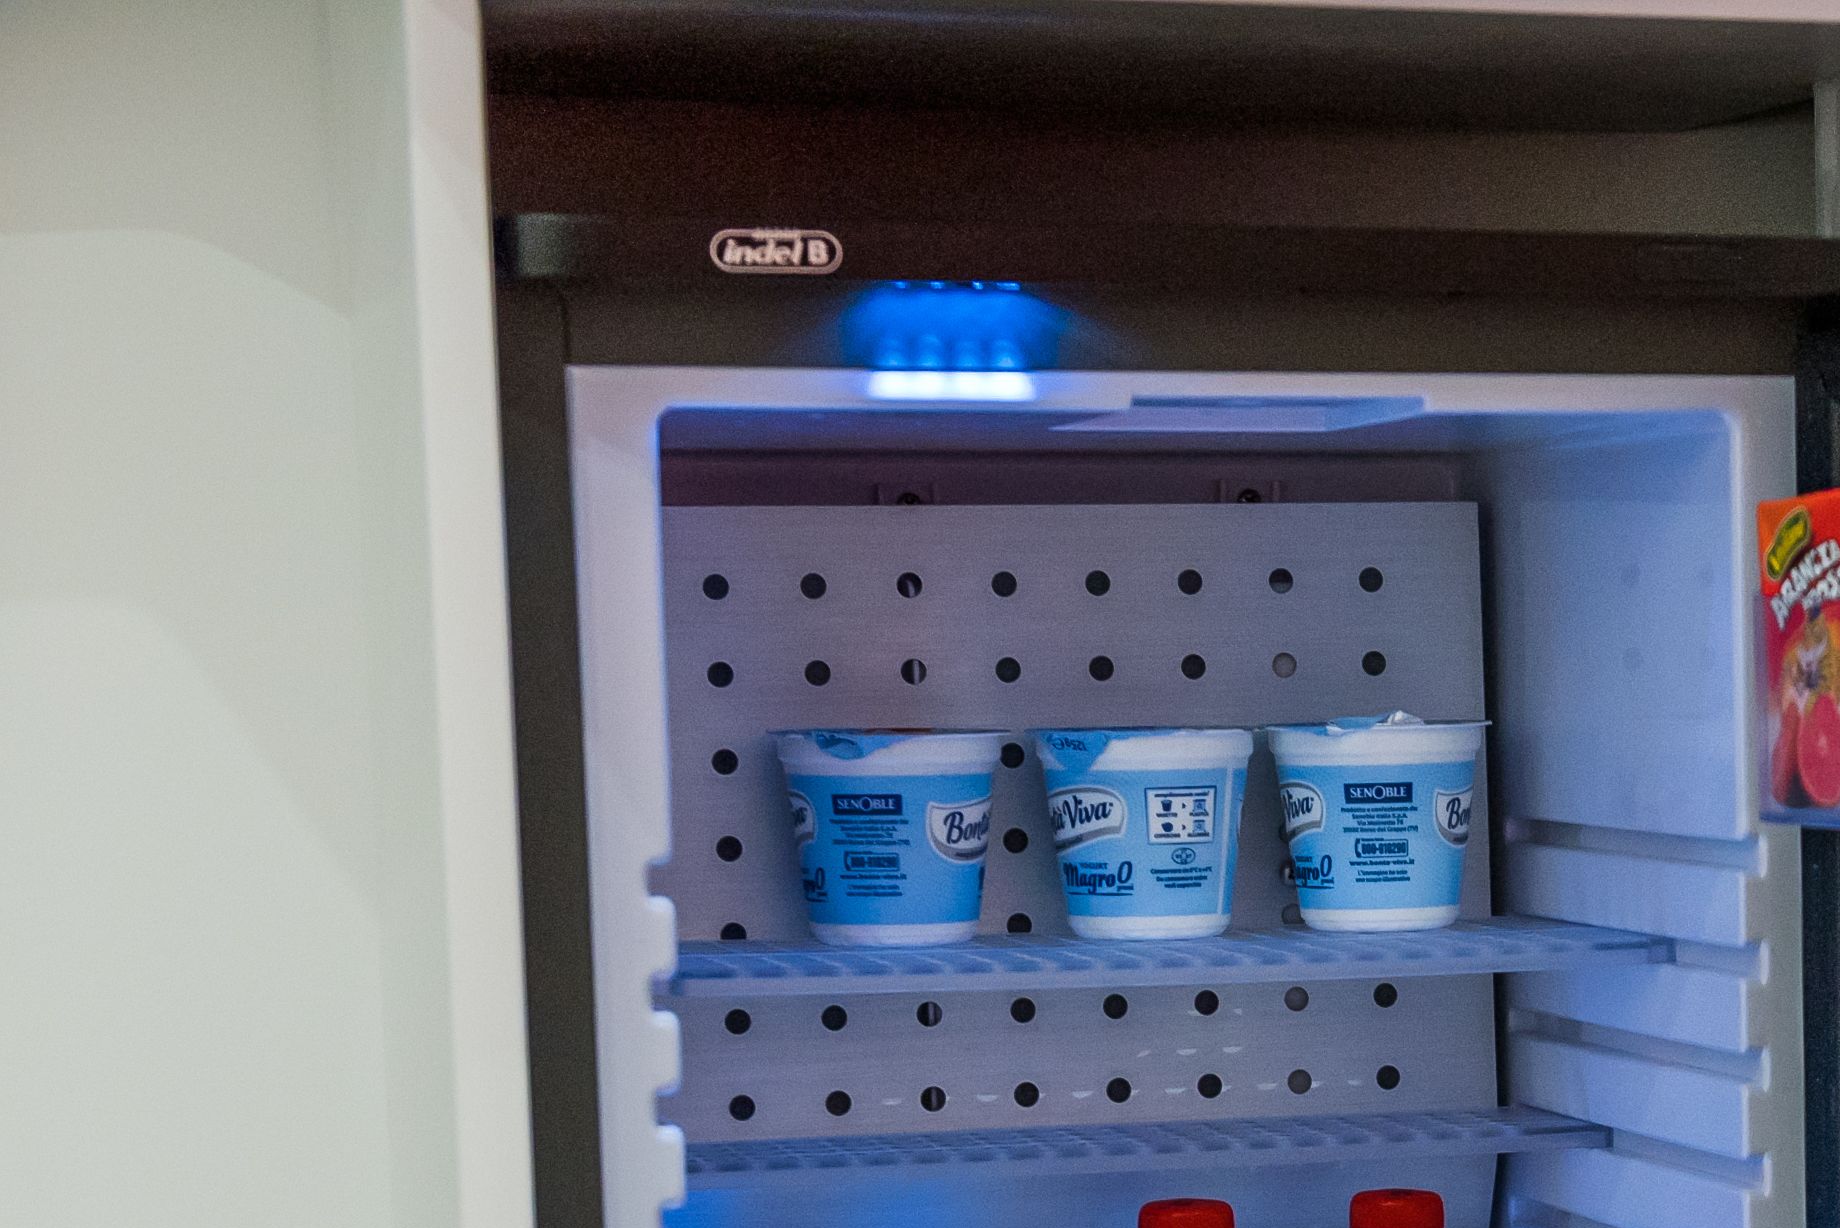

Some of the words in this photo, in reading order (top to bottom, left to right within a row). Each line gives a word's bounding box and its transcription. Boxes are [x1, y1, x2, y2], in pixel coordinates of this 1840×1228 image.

[723, 238, 804, 265] indel
[807, 239, 829, 265] B
[837, 796, 896, 811] SENOBLE
[1282, 789, 1314, 823] Viva
[1350, 785, 1407, 800] SENOBLE
[1062, 795, 1113, 829] Viva
[1062, 862, 1116, 895] Magro
